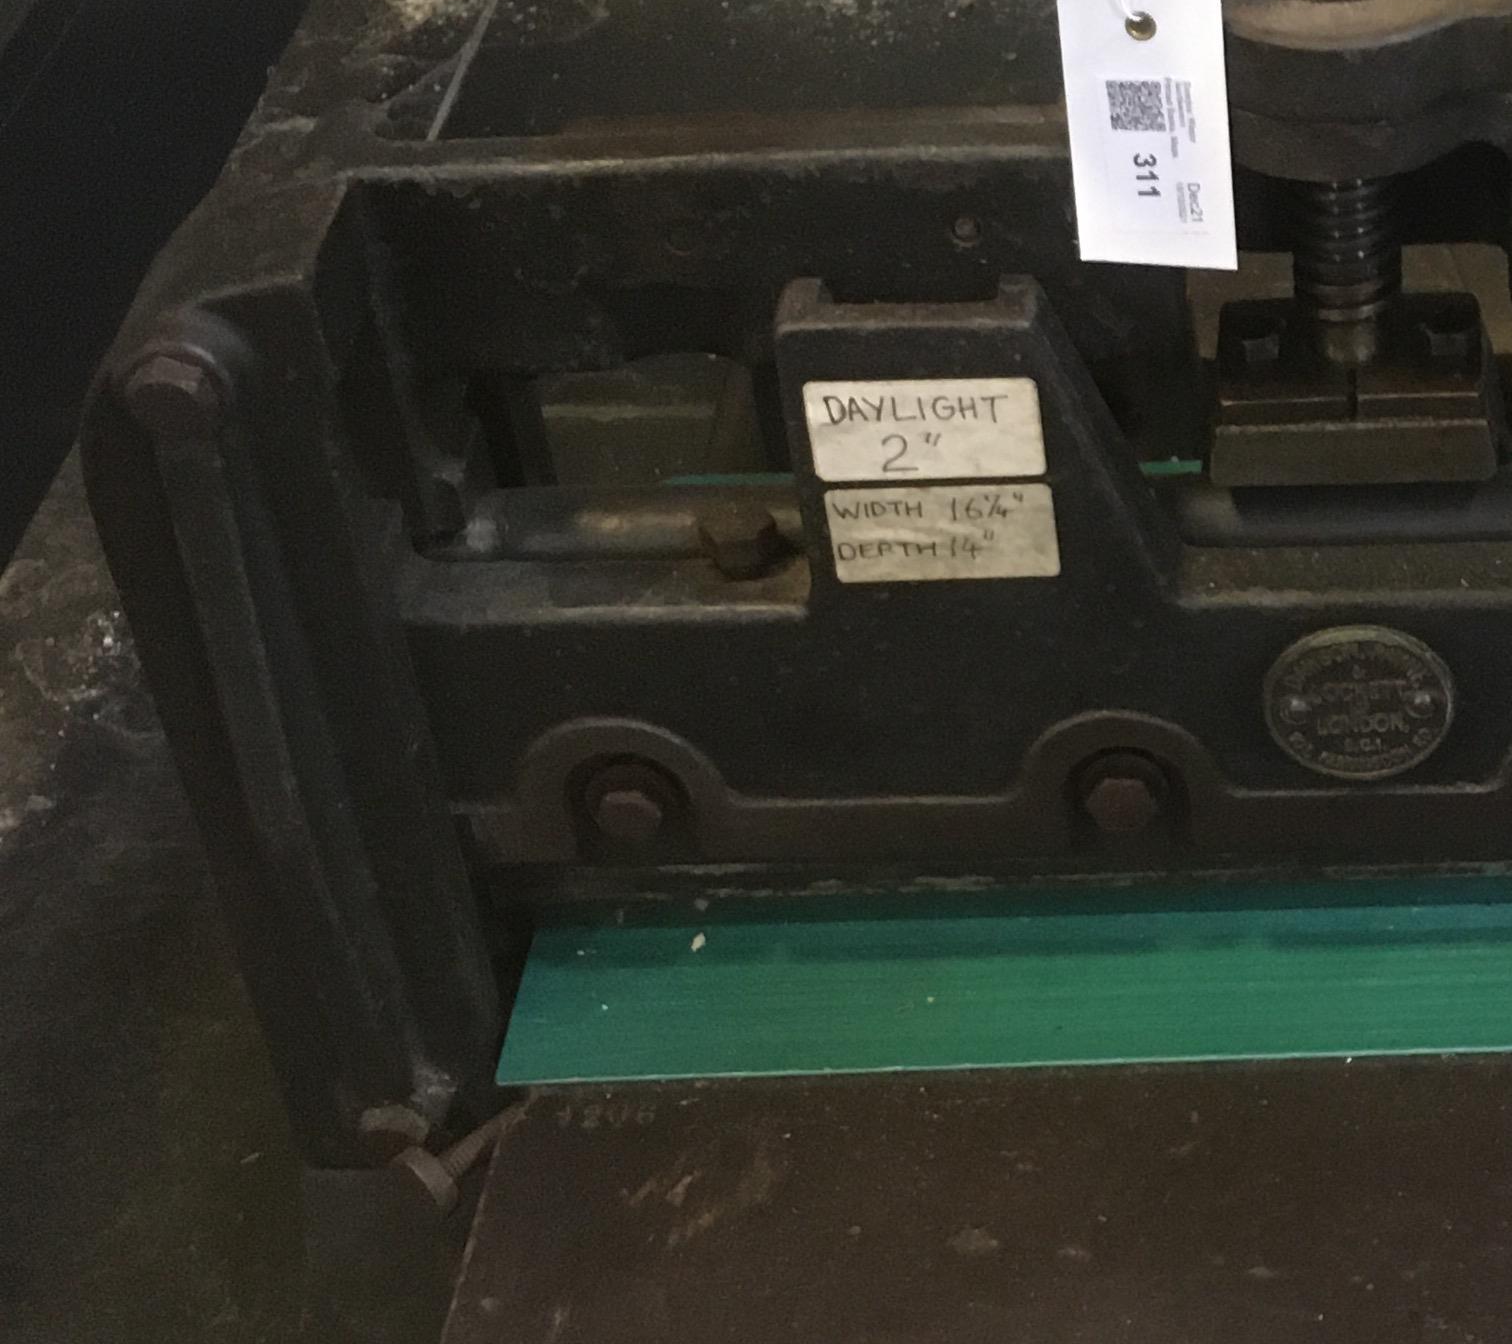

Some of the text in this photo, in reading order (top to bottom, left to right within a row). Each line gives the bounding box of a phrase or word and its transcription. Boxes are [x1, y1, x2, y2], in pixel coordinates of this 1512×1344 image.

[1133, 152, 1161, 199] 311
[822, 394, 1008, 425] DAYLIGHT
[831, 501, 923, 520] WIDTH
[836, 541, 937, 561] DEPTH
